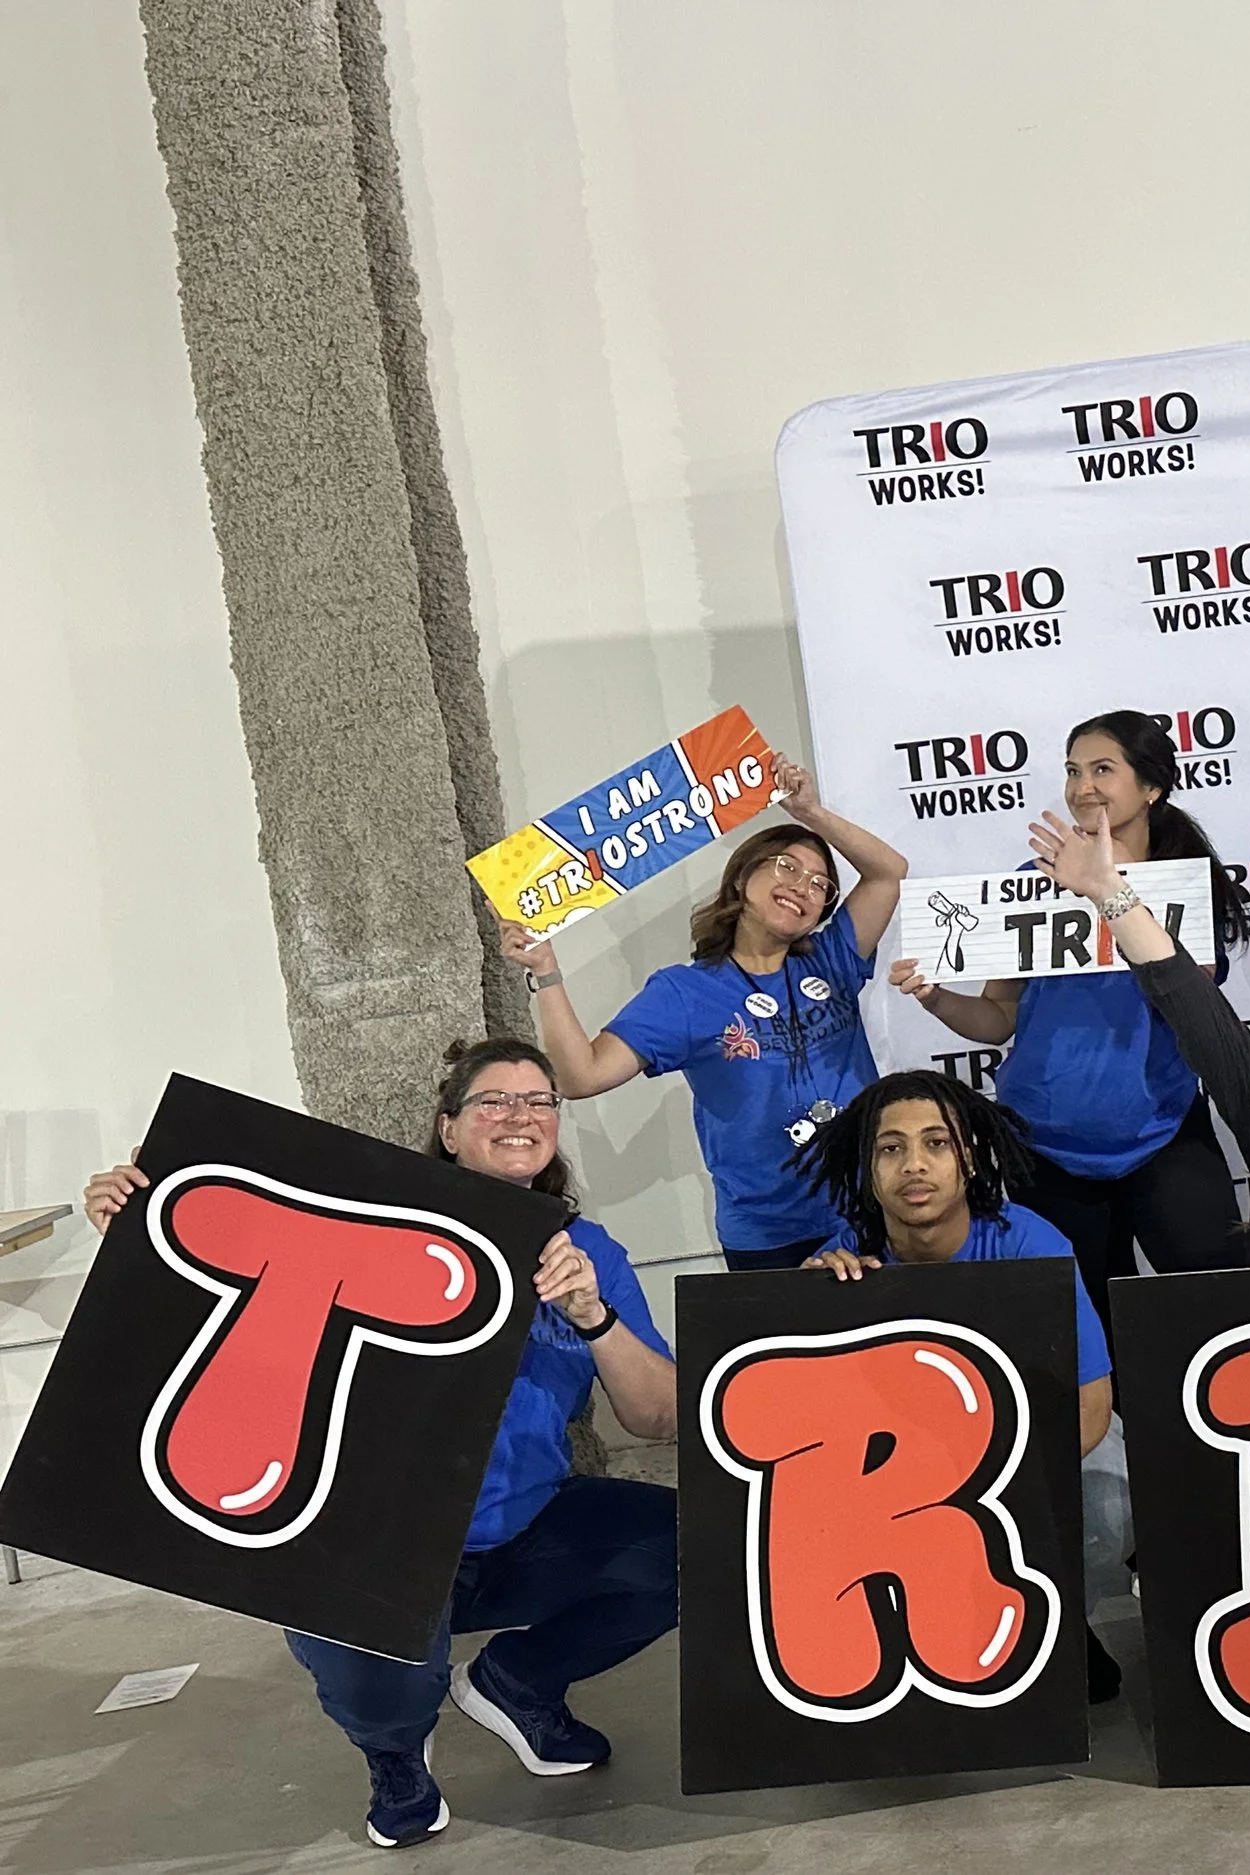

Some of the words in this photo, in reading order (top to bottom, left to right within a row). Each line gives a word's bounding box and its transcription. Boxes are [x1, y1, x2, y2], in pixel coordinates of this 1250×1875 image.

[853, 418, 988, 468] TRIO
[1062, 392, 1198, 445] TRIO
[869, 469, 984, 505] WORKS!
[1078, 443, 1193, 482] WORKS!
[930, 568, 1064, 619] TRIO
[946, 619, 1061, 656] WORKS!
[894, 731, 1028, 782] TRIO
[577, 806, 596, 836] I
[608, 769, 662, 820] AM
[910, 782, 1024, 819] WORKS!
[517, 756, 763, 919] #TRIOSTRONG
[981, 879, 989, 904] I
[140, 1164, 513, 1548] T
[699, 1319, 1061, 1722] R
